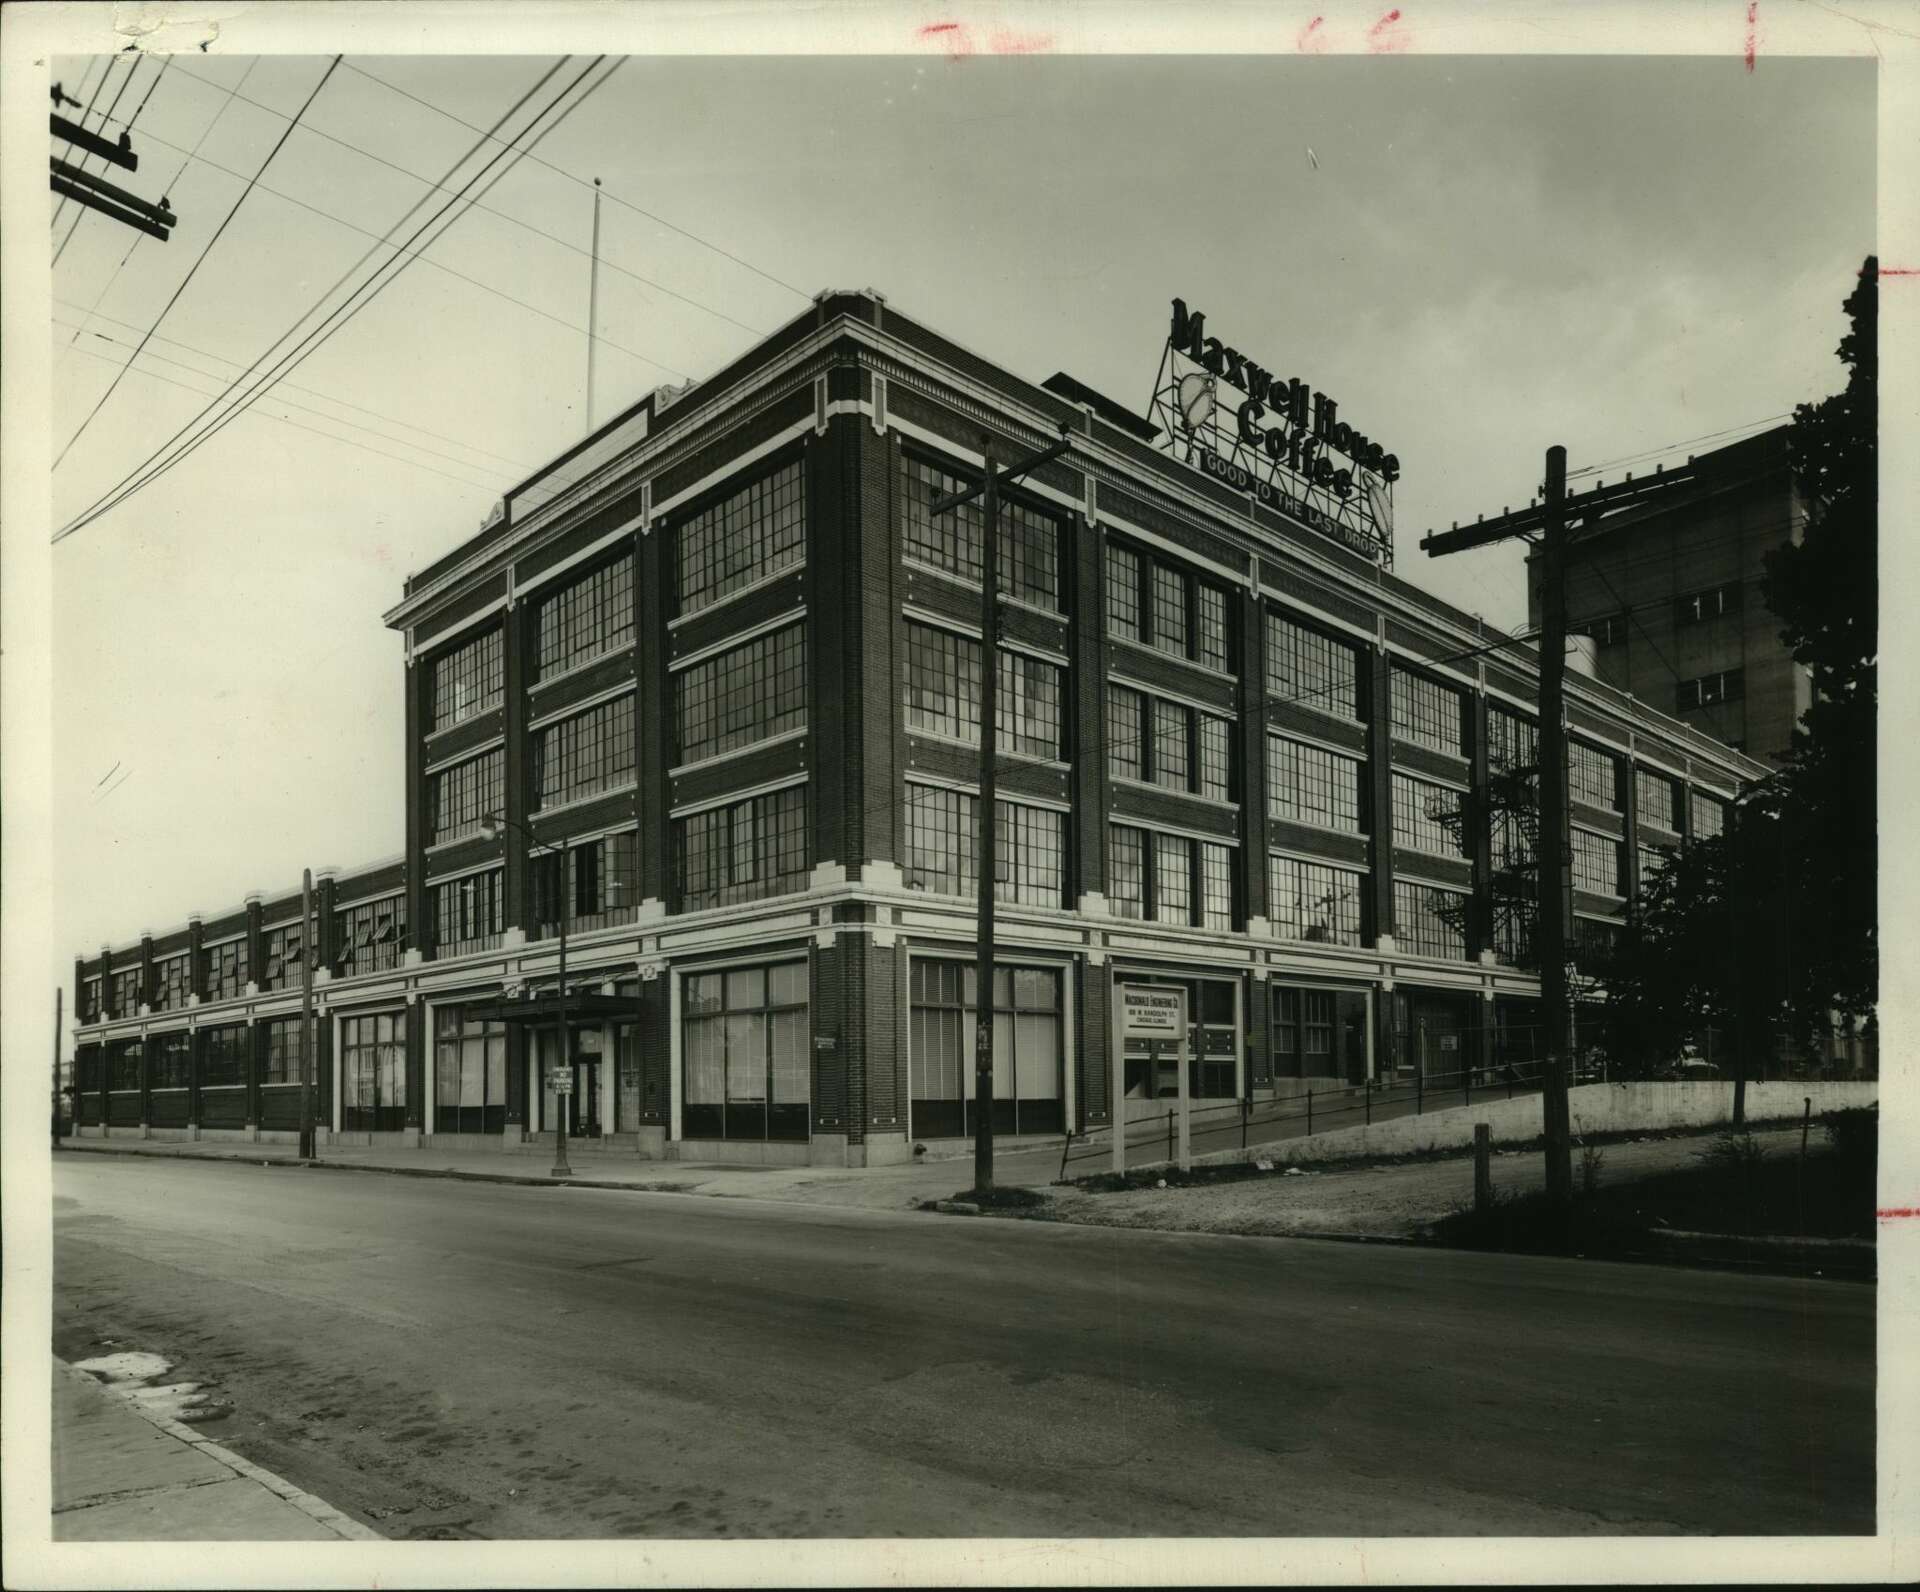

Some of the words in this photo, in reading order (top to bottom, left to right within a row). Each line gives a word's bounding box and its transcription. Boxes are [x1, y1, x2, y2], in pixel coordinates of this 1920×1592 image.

[1171, 297, 1310, 429] Maxwell
[1313, 391, 1400, 482] House
[1237, 400, 1353, 499] Coffee
[1206, 453, 1248, 488] GOOD
[1254, 480, 1272, 500] TO
[1276, 490, 1303, 518] THE
[1307, 511, 1341, 535] LAST
[1344, 530, 1378, 554] DROP
